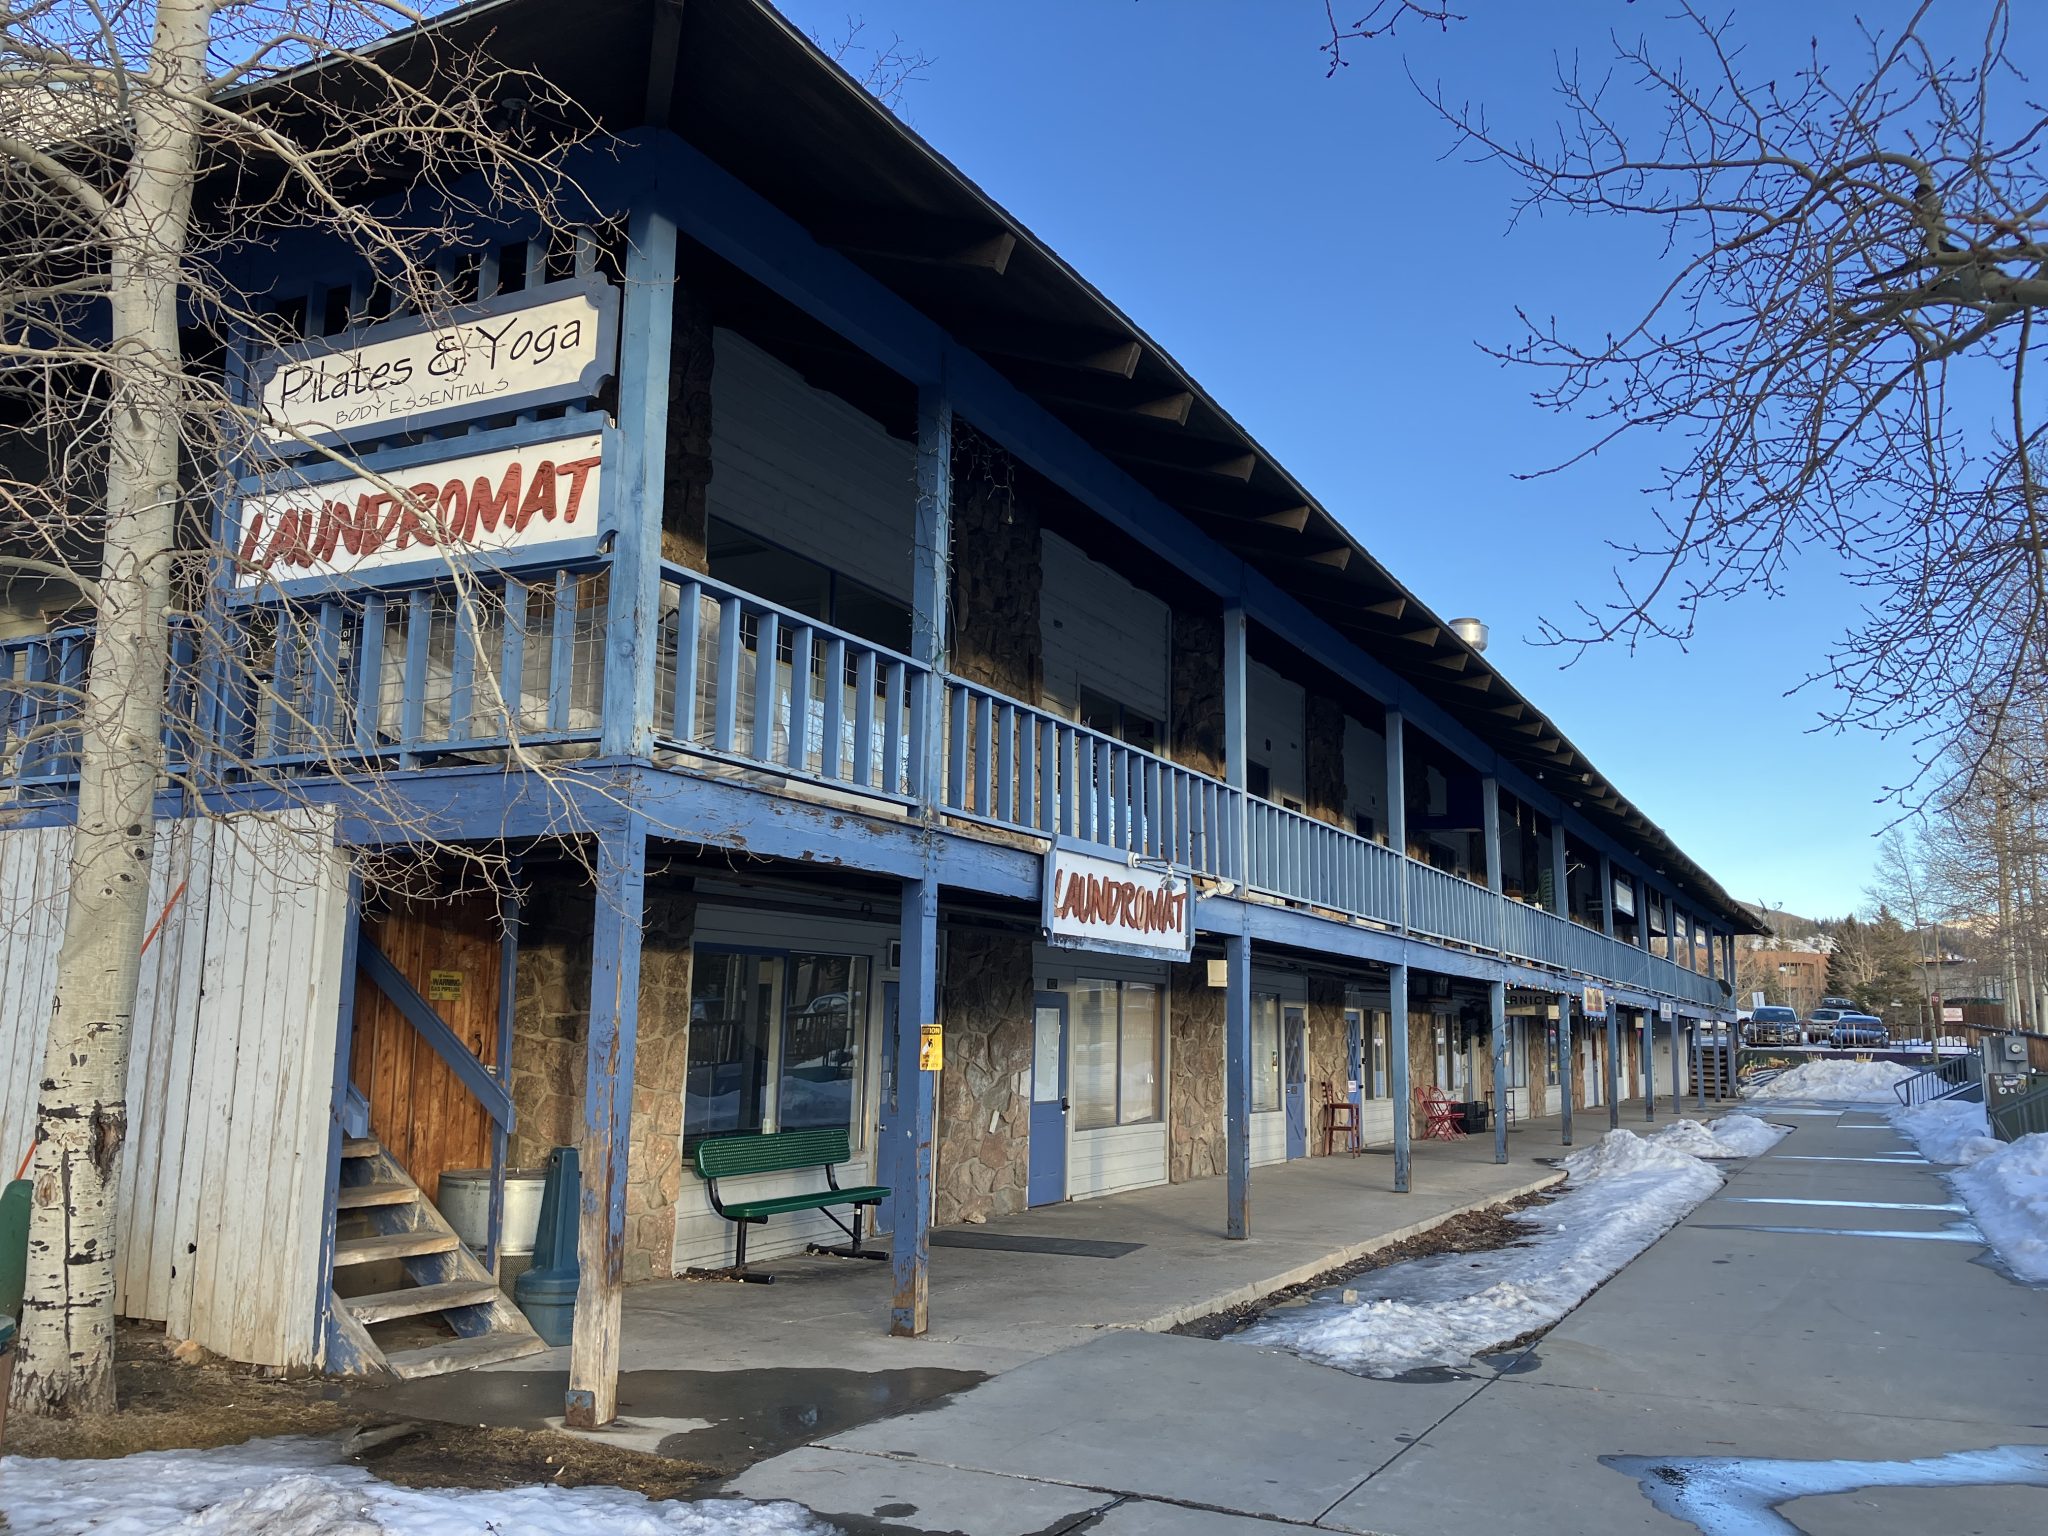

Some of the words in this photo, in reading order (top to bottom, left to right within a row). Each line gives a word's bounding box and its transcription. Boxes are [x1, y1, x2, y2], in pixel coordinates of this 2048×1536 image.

[281, 352, 413, 410] Pilates
[428, 335, 463, 377] &
[476, 317, 581, 370] Yoga
[336, 401, 385, 425] BODY
[389, 377, 509, 414] ESSENTIALS
[235, 456, 601, 574] LAUNDROMAT
[1054, 869, 1186, 934] LAUNDROMAT
